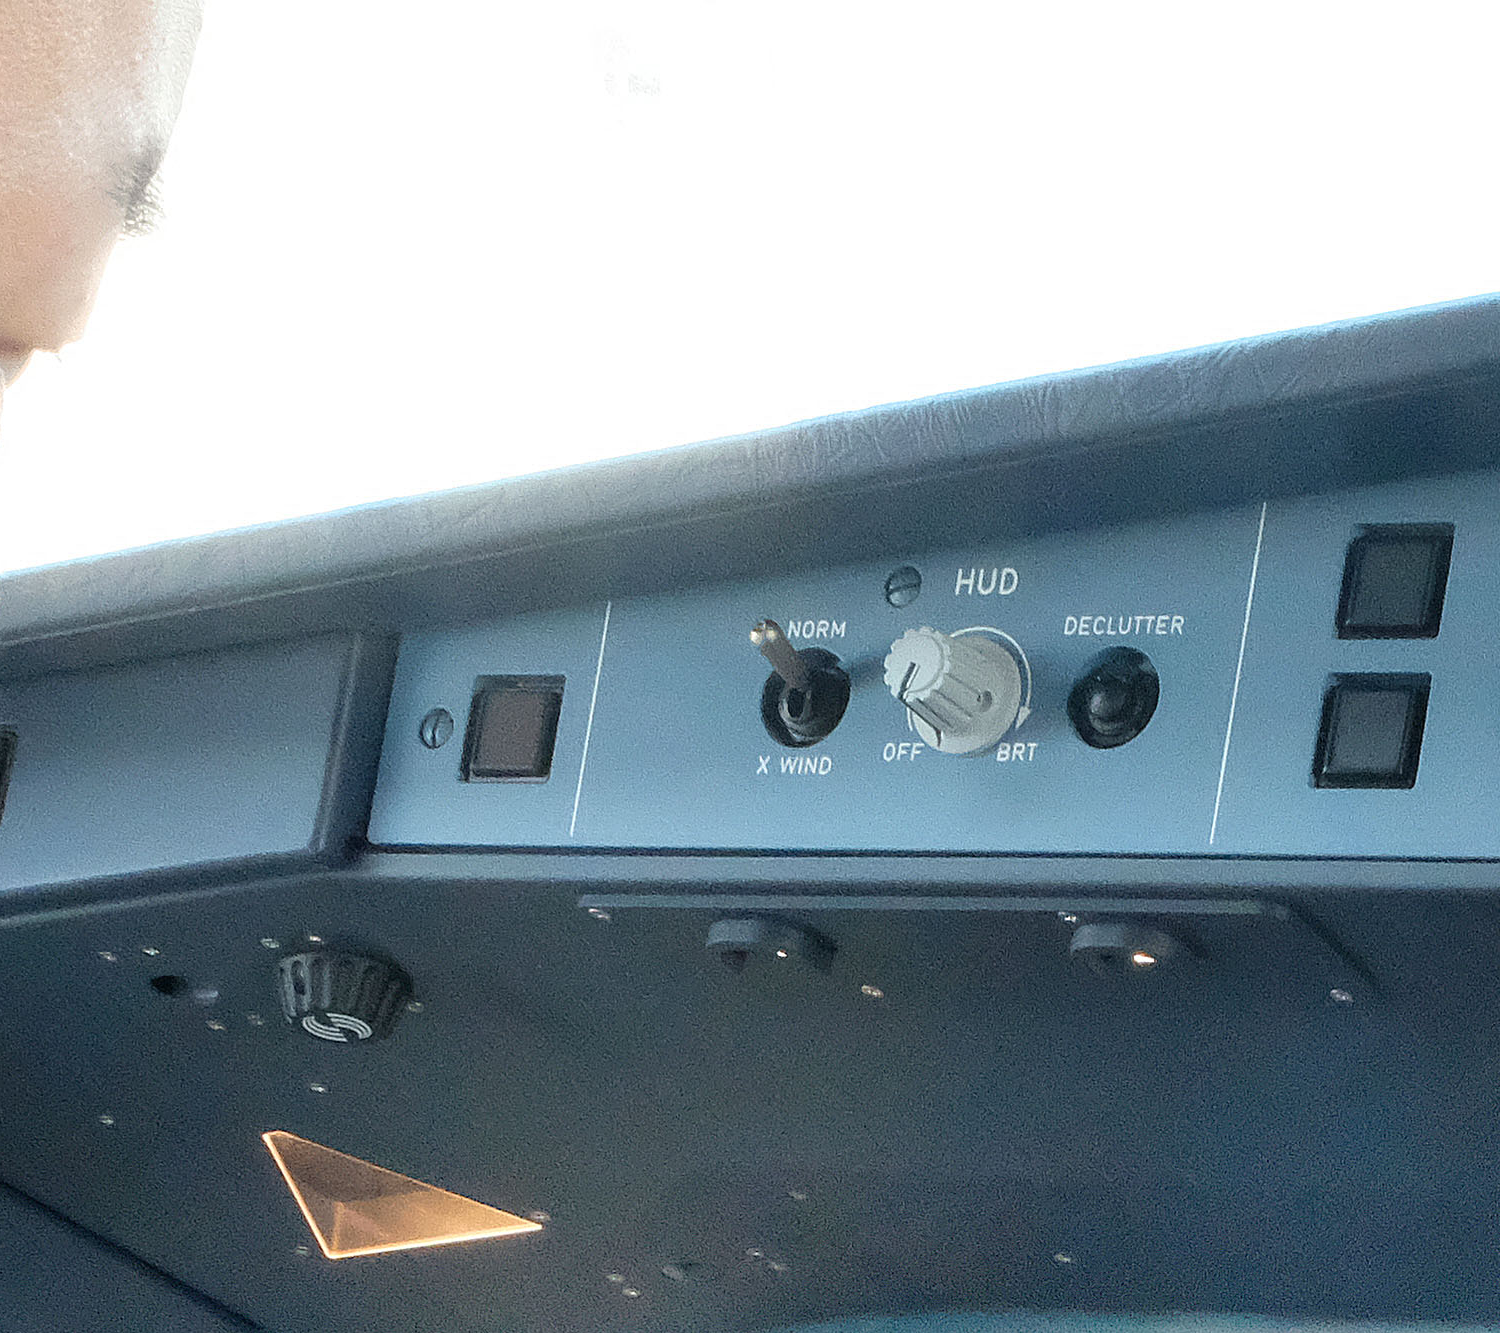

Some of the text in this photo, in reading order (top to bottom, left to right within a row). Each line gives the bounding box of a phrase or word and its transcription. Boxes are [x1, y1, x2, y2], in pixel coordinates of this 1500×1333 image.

[954, 567, 1019, 597] HUD
[787, 619, 846, 641] NORM
[1063, 614, 1185, 637] DECLUTTER
[756, 754, 833, 776] X WIND
